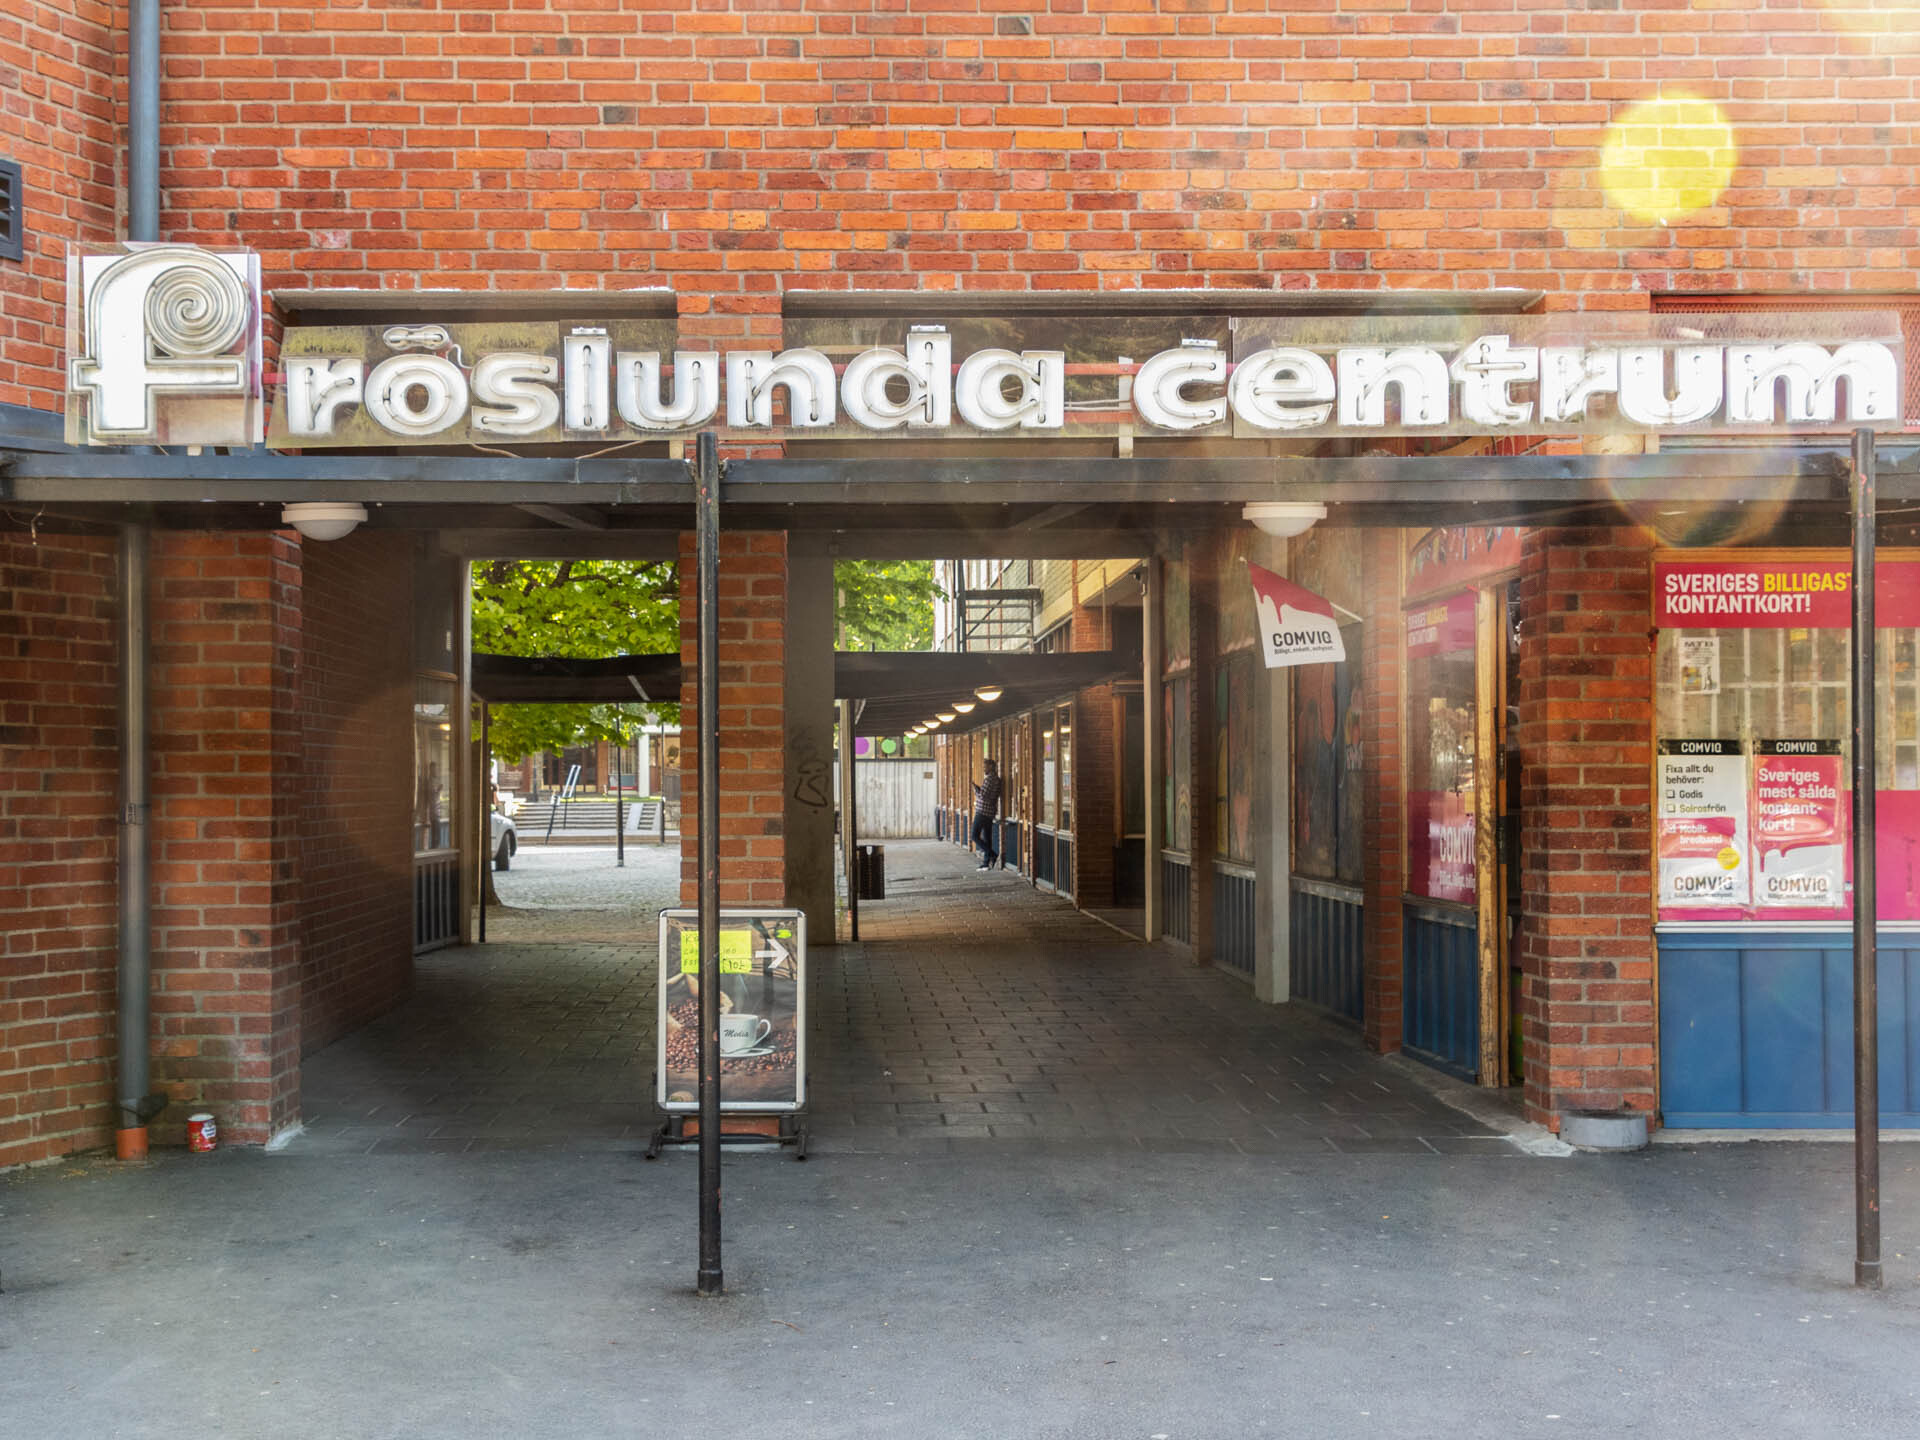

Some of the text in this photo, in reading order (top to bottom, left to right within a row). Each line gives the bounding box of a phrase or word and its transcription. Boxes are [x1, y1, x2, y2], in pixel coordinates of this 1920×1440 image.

[1133, 334, 1899, 430] centrum
[1665, 573, 1759, 593] SVERIGES
[1665, 594, 1811, 614] KONTANTKORT!
[1272, 630, 1333, 647] COMVIQ
[1681, 742, 1722, 753] COMVIQ
[1776, 741, 1818, 753] COMVIQ
[1666, 764, 1714, 773] Fixa allt du
[1759, 768, 1820, 785] Sveriges
[1679, 790, 1703, 799] Godis
[1760, 784, 1836, 798] mest sålda
